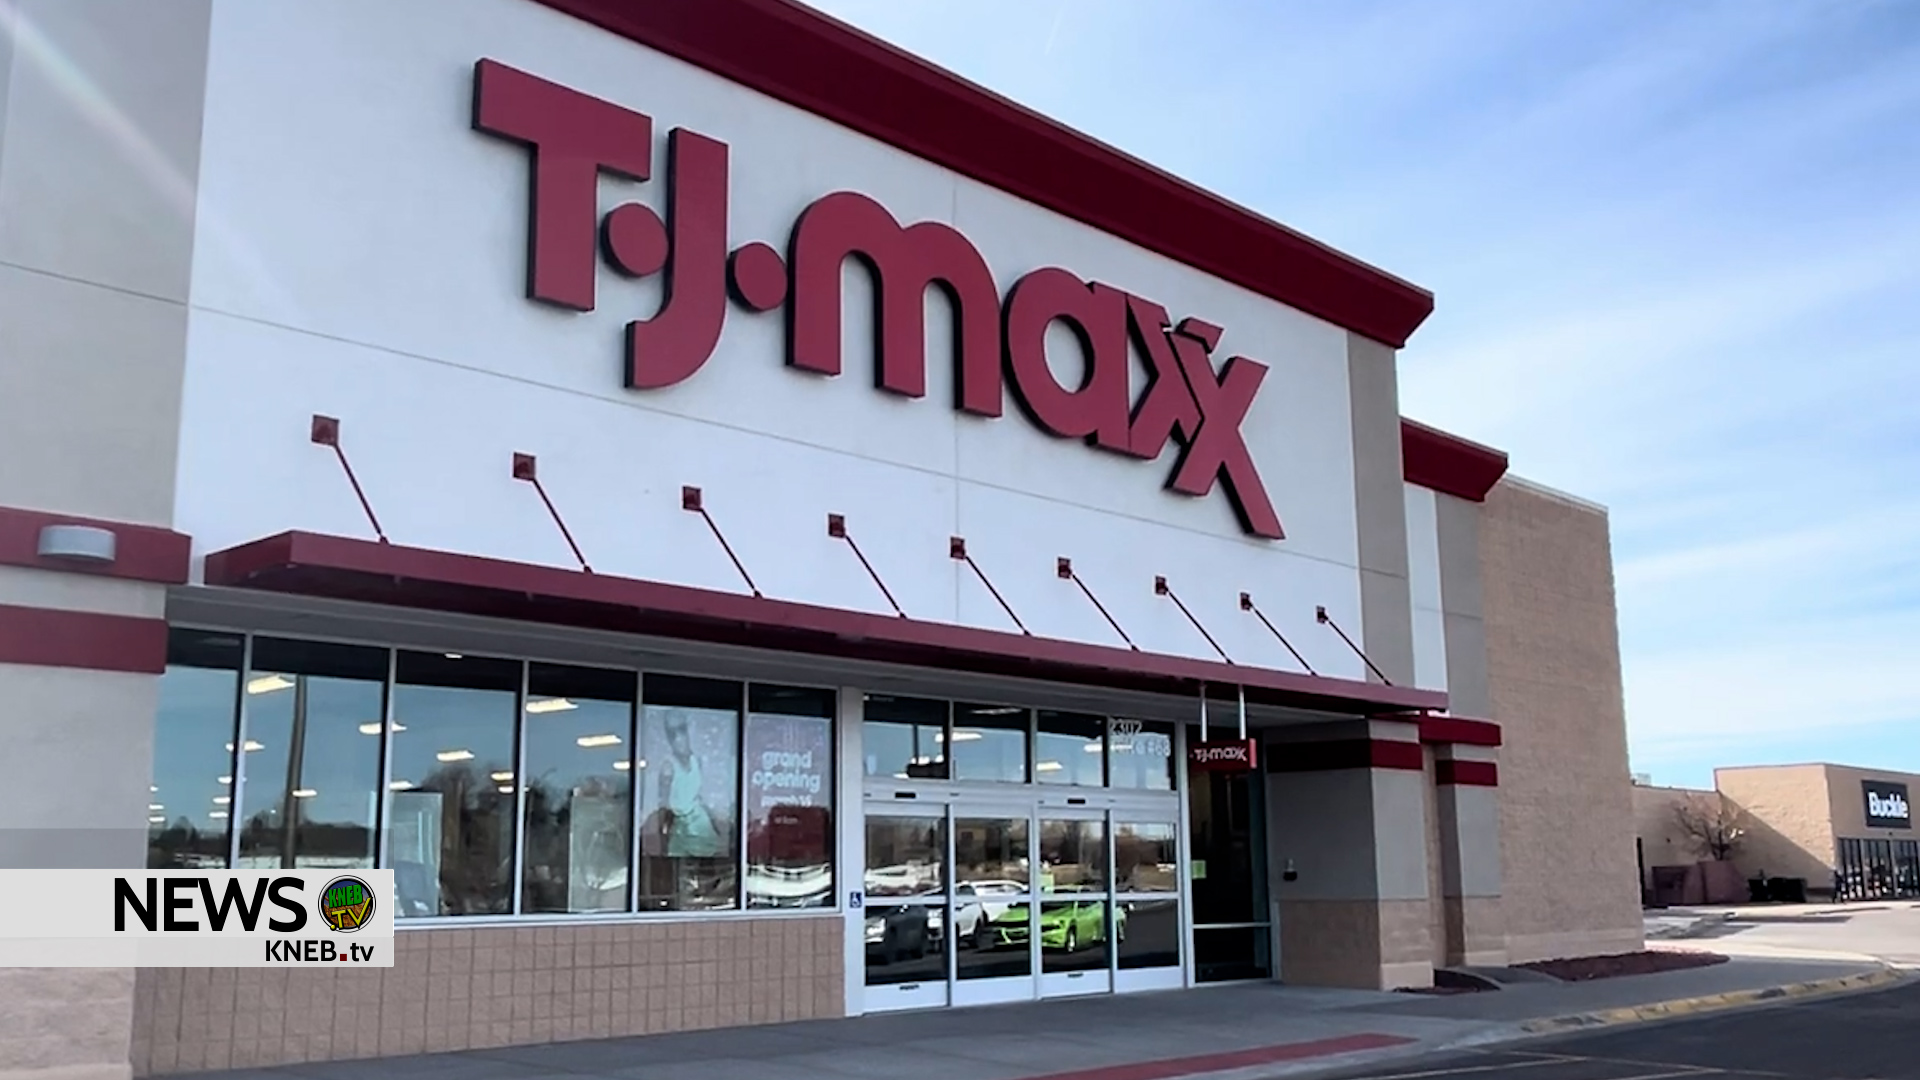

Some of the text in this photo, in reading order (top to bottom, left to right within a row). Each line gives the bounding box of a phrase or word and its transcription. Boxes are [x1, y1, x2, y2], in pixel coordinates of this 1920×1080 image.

[762, 750, 812, 770] grand
[752, 770, 821, 793] opening
[1868, 791, 1909, 818] Buckle
